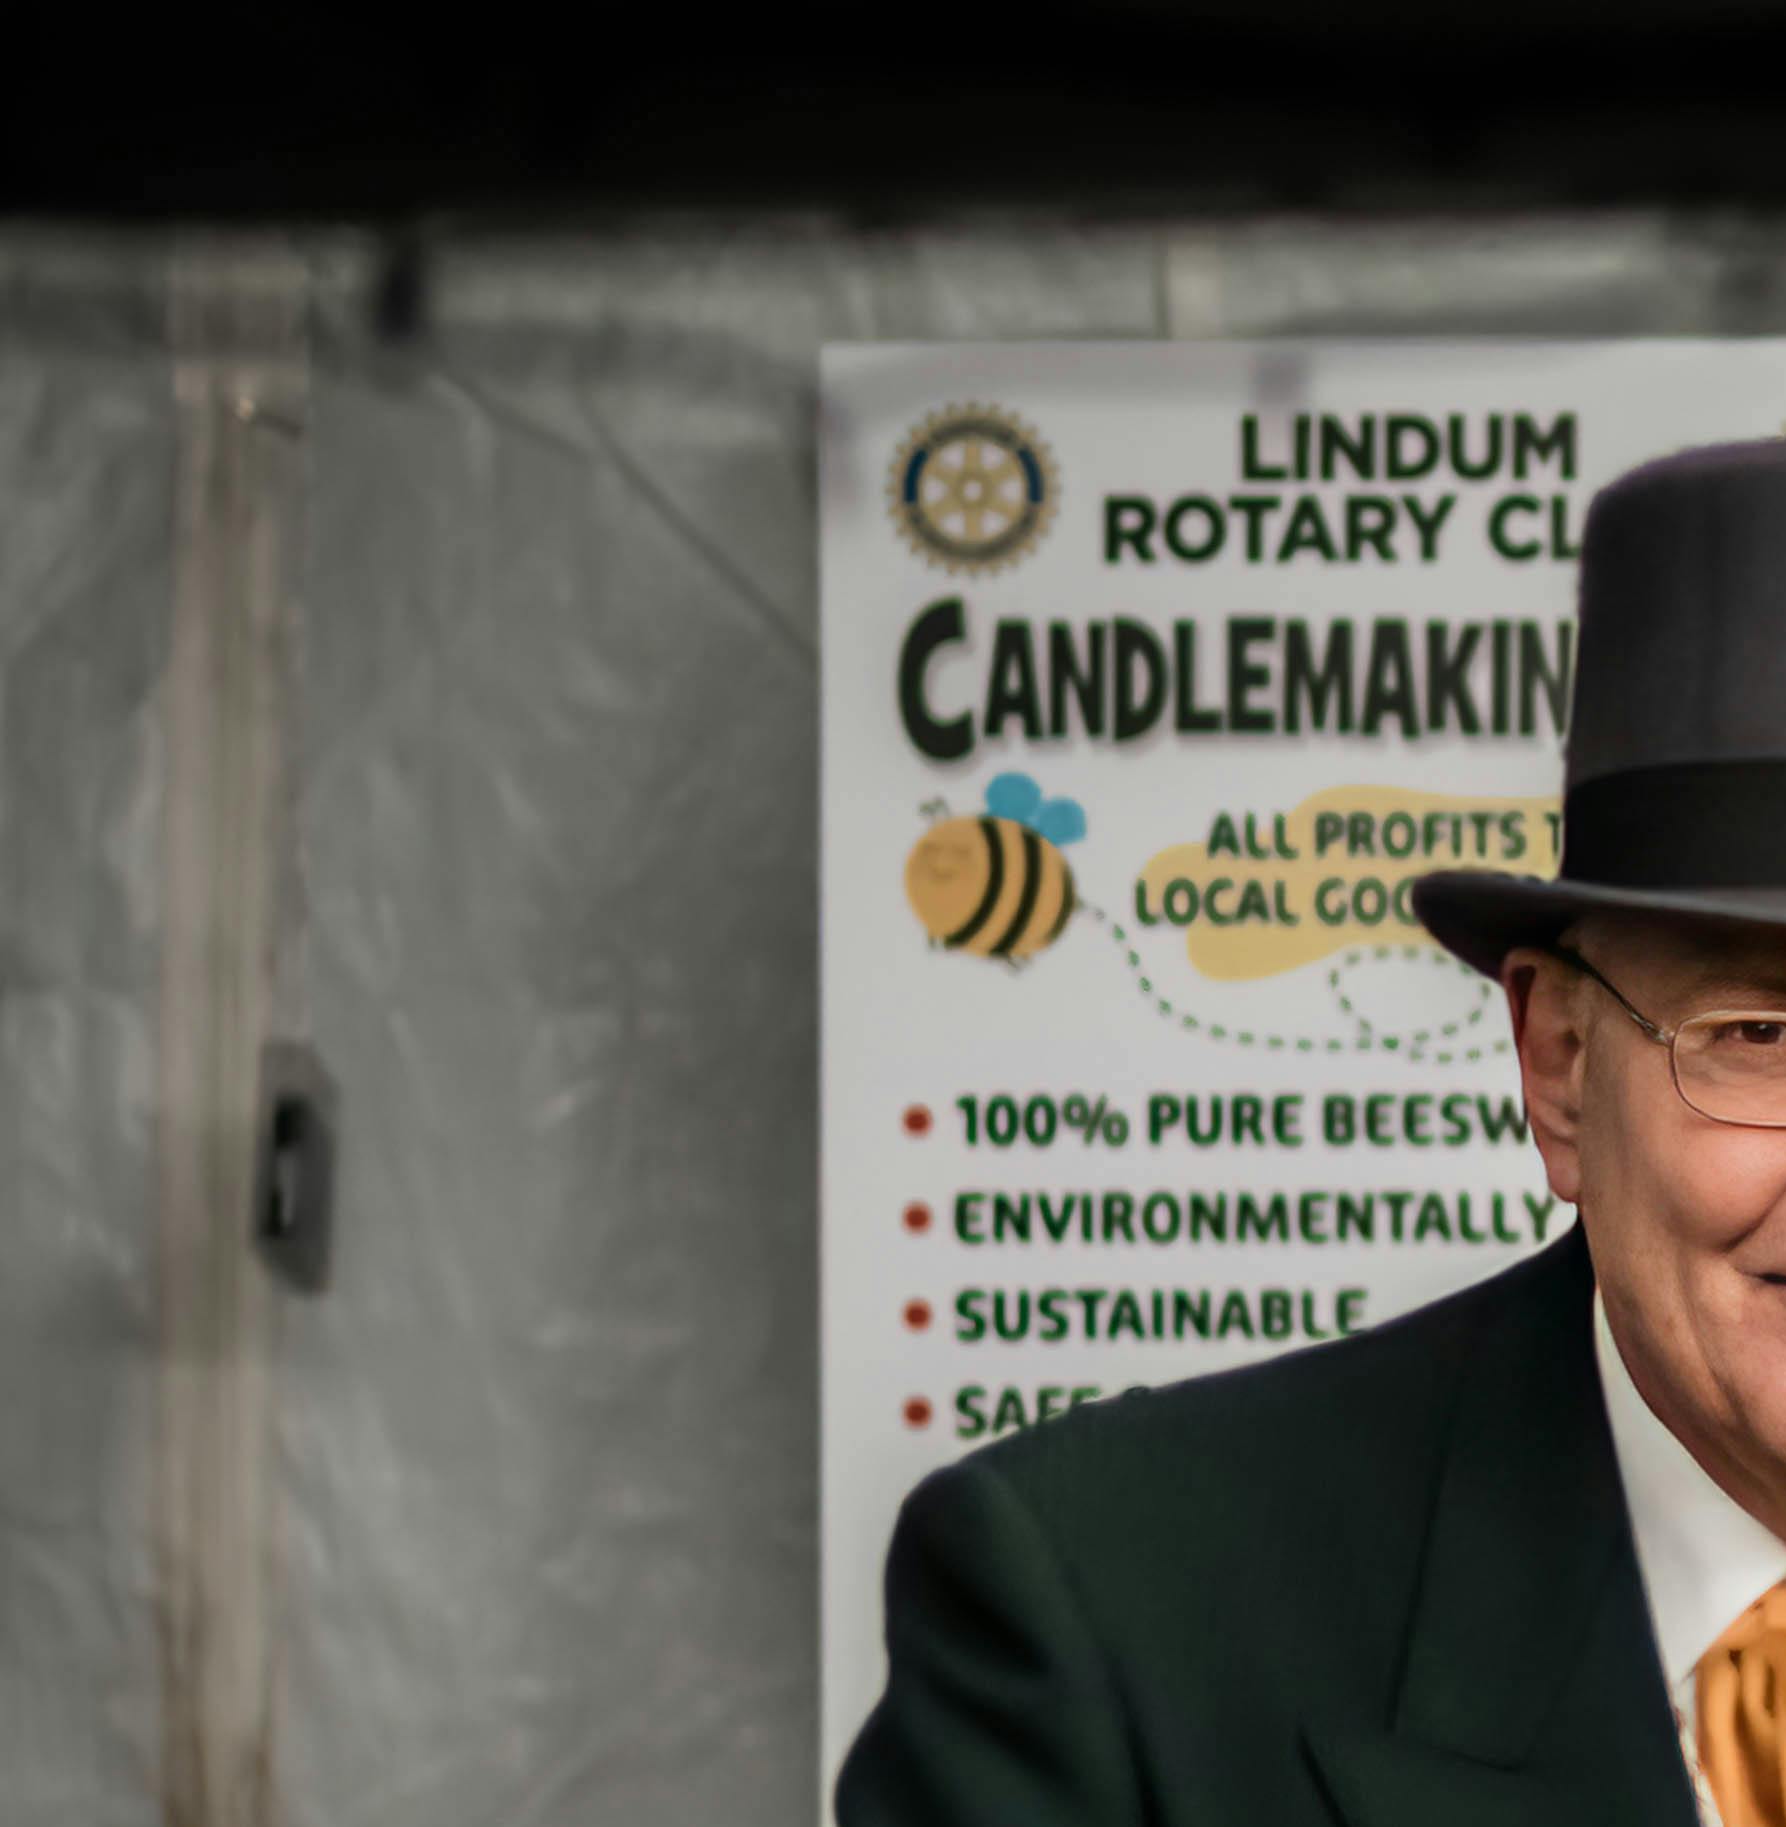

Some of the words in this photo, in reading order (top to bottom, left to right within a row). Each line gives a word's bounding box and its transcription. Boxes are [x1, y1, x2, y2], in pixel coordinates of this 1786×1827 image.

[1239, 412, 1578, 482] LINDUM
[1102, 494, 1457, 564] ROTARY
[1486, 493, 1579, 564] CL
[895, 595, 1573, 764] CANDLEMAKIN
[1205, 811, 1300, 860] ALL
[1313, 810, 1528, 861] PROFITS
[1134, 876, 1299, 928] LOCAL
[955, 1093, 1130, 1147] 100%
[1147, 1093, 1303, 1147] PURE
[1322, 1092, 1529, 1147] BEESW
[953, 1190, 1556, 1245] ENVIRONMENTALLY
[953, 1288, 1368, 1343] SUSTAINABLE
